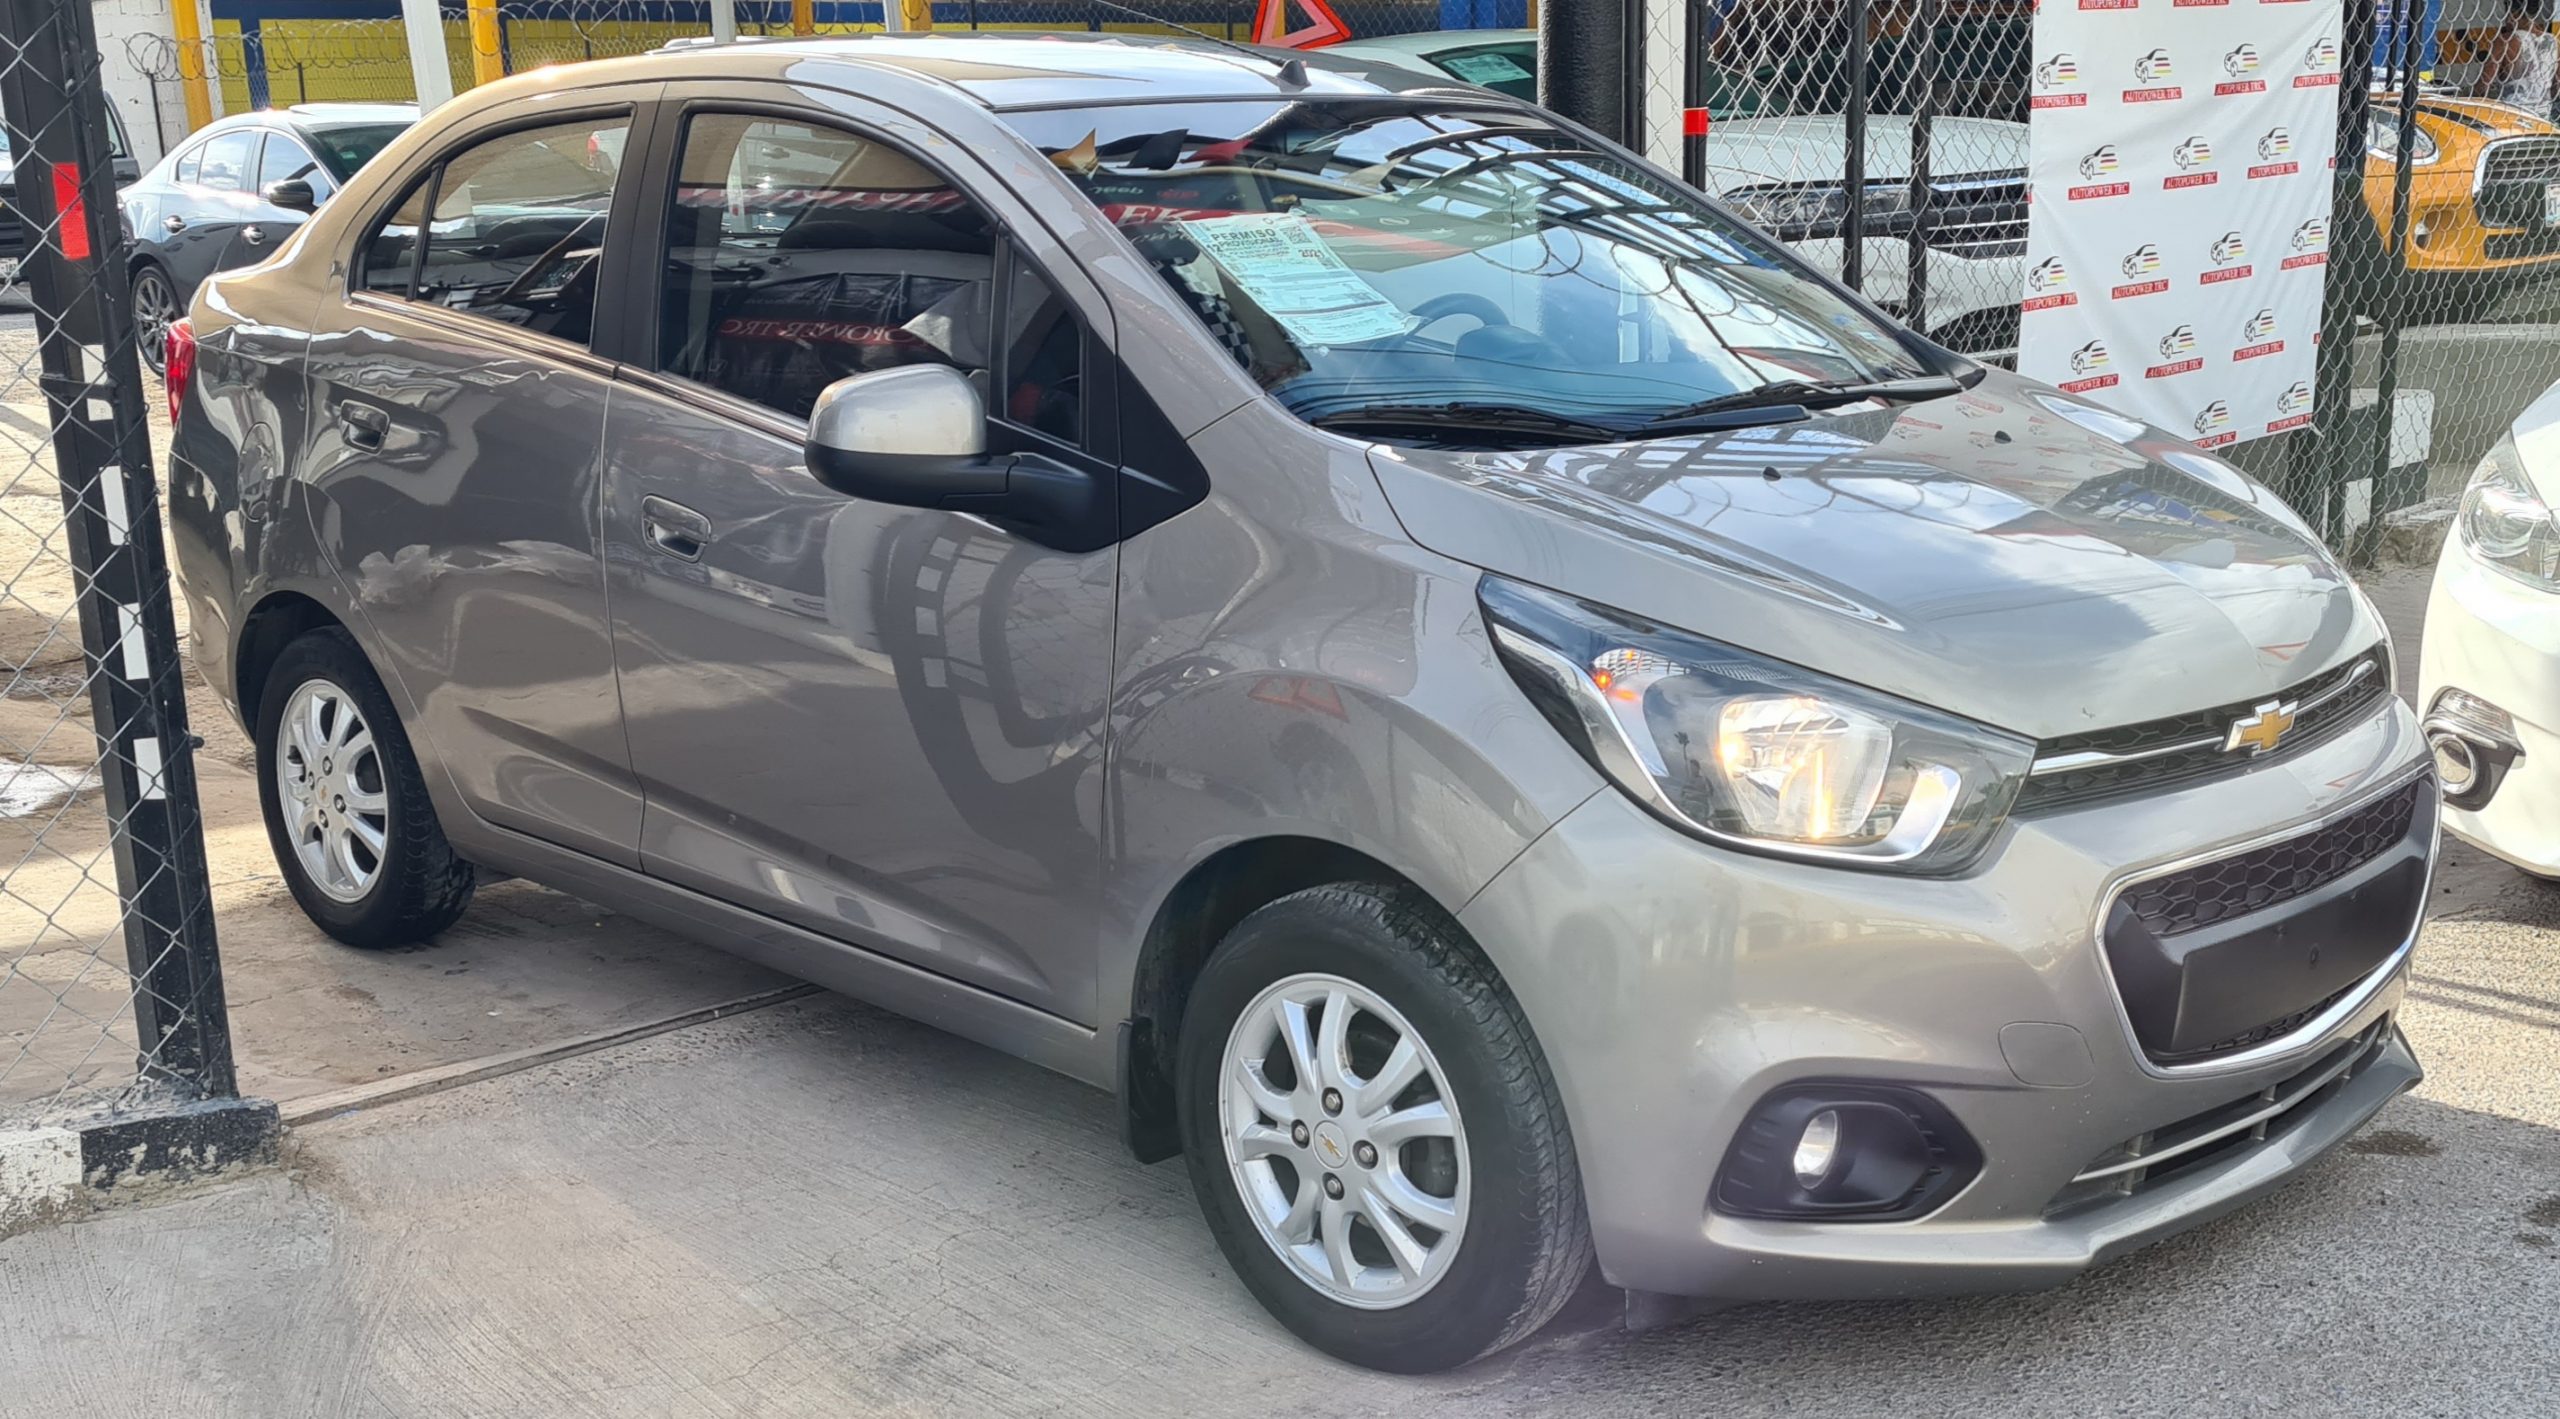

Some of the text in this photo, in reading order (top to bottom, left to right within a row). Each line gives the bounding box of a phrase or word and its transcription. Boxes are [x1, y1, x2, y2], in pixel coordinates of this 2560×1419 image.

[2125, 88, 2180, 101] AUTOPOWER TRC
[2031, 96, 2070, 108] UTOPOWER
[2250, 164, 2284, 178] AUTOPOWER
[2165, 174, 2202, 188] AUTOPOWER
[2070, 183, 2128, 199] AUTOPOWER TRC
[1211, 228, 1276, 241] PERMISO
[2201, 268, 2238, 283] AUTOPOWER
[2113, 282, 2152, 298] AUTOPOWER
[2023, 295, 2061, 311] UTOPOWER
